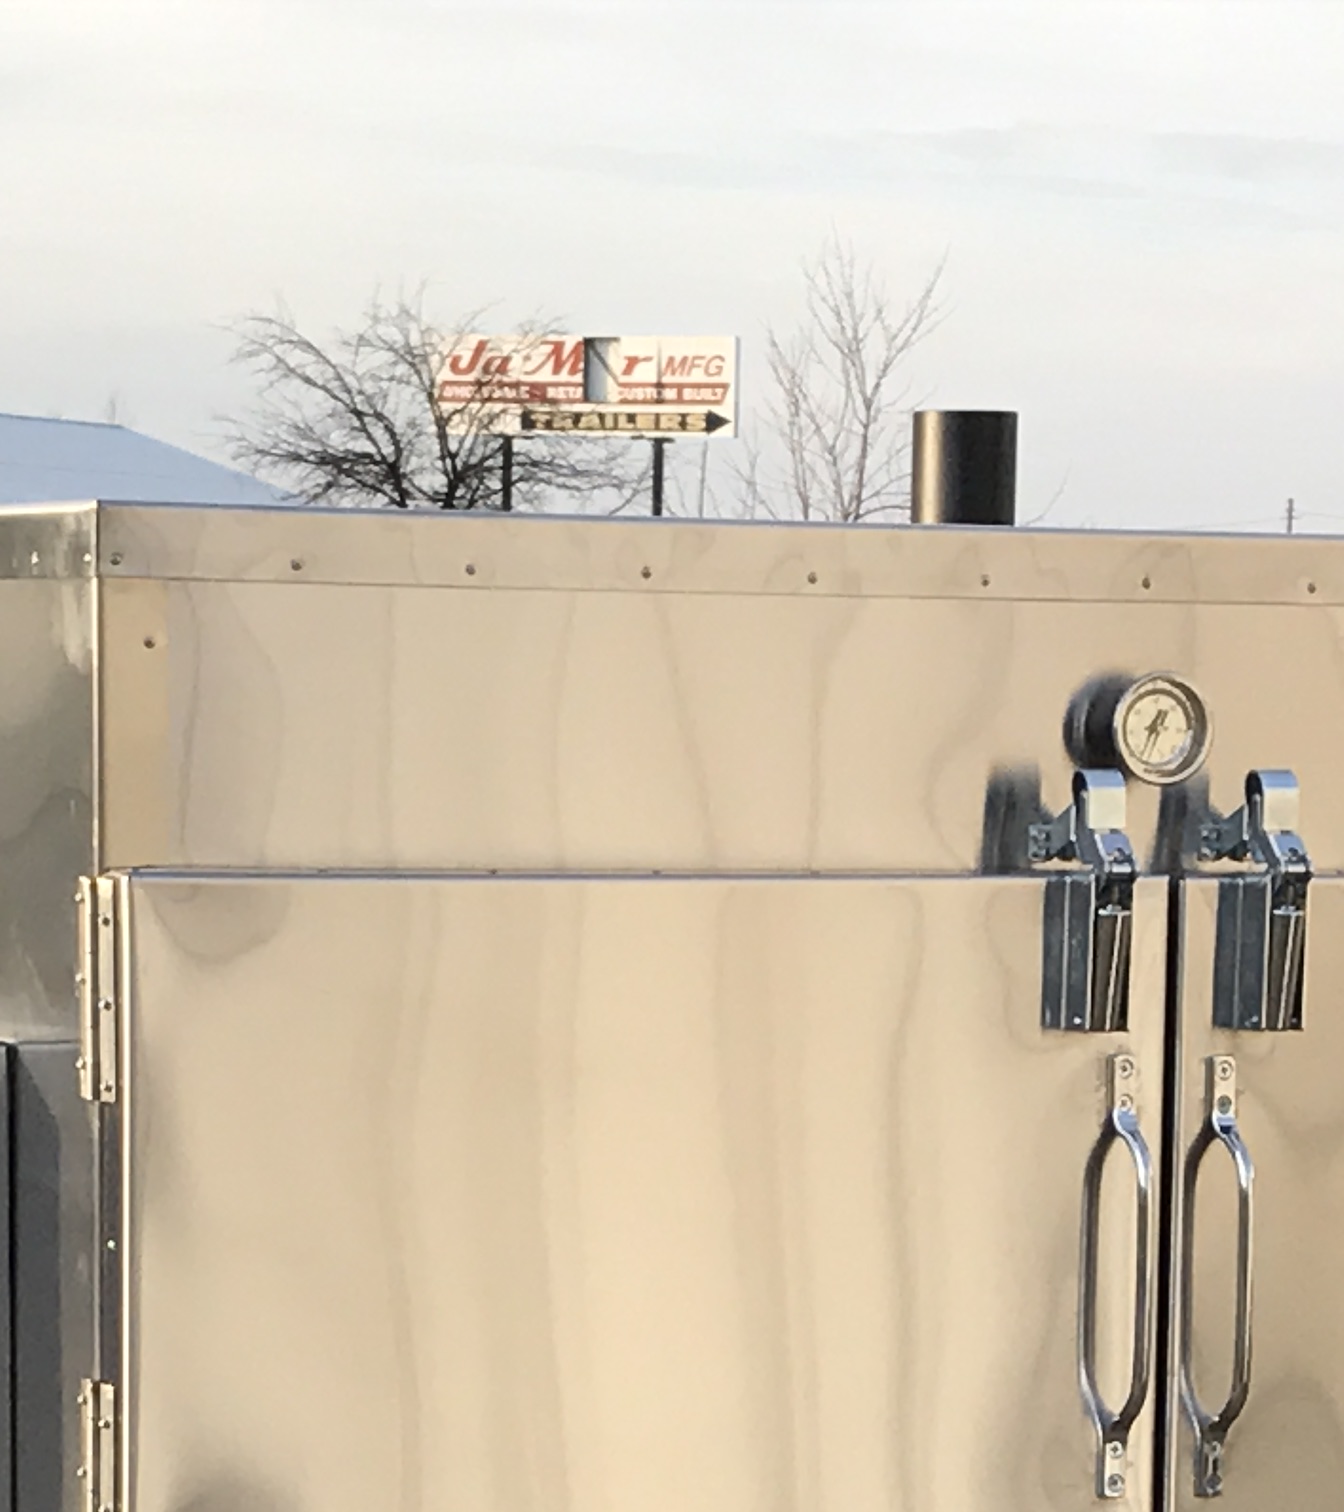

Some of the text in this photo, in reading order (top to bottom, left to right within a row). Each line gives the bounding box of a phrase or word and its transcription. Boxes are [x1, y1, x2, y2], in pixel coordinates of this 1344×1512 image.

[663, 355, 726, 376] MFG
[682, 388, 725, 401] BUILT
[532, 412, 707, 431] TRAILERS
